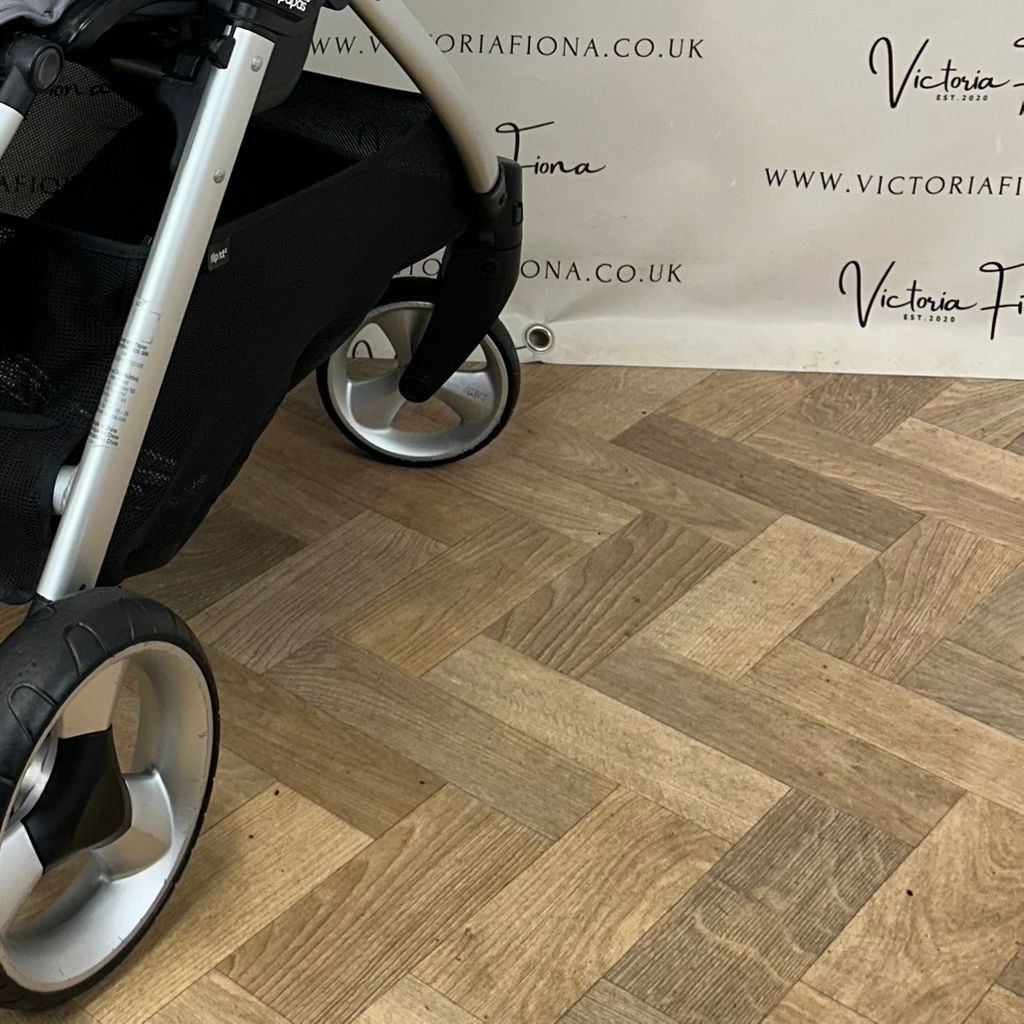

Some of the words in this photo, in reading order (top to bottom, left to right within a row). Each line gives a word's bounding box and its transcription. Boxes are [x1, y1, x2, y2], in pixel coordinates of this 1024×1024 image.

[868, 36, 1012, 109] Victoria
[935, 93, 989, 102] EST.2020
[838, 260, 978, 328] Victoria
[903, 314, 956, 323] EST.2020
